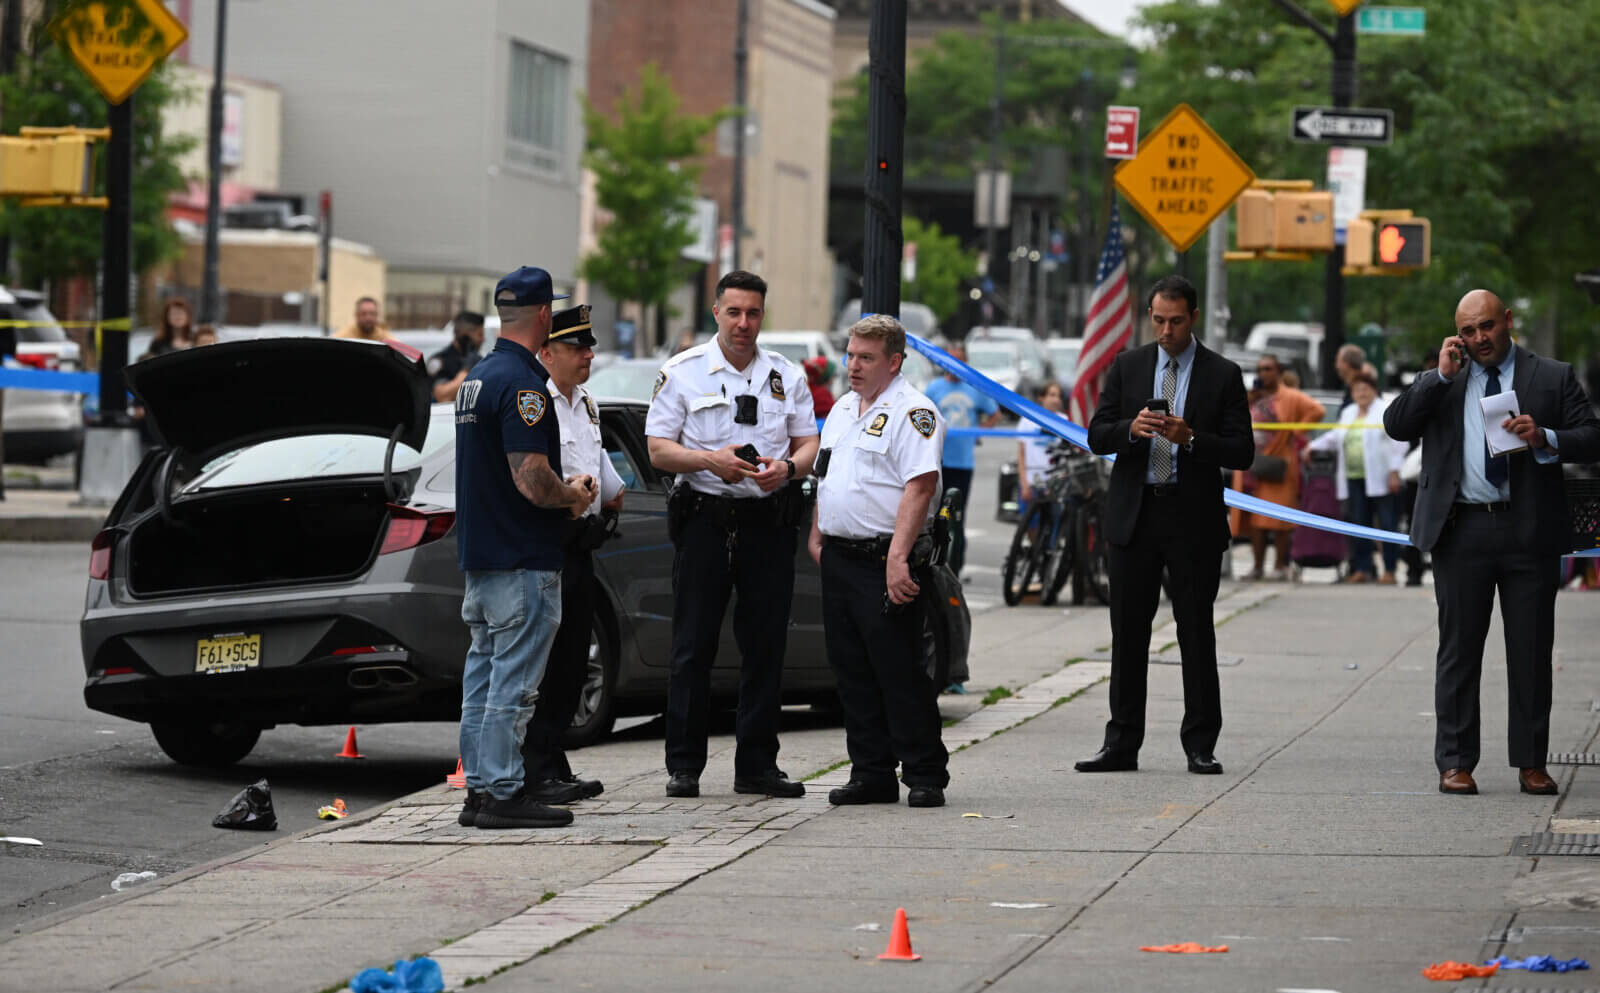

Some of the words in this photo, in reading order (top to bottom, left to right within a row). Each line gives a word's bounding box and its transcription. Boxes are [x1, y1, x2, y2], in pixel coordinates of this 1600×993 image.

[94, 53, 143, 67] AHEAD
[1167, 134, 1200, 149] TWO
[1167, 157, 1199, 170] WAY
[1151, 177, 1214, 194] TRAFFIC
[1157, 199, 1208, 214] AHEAD
